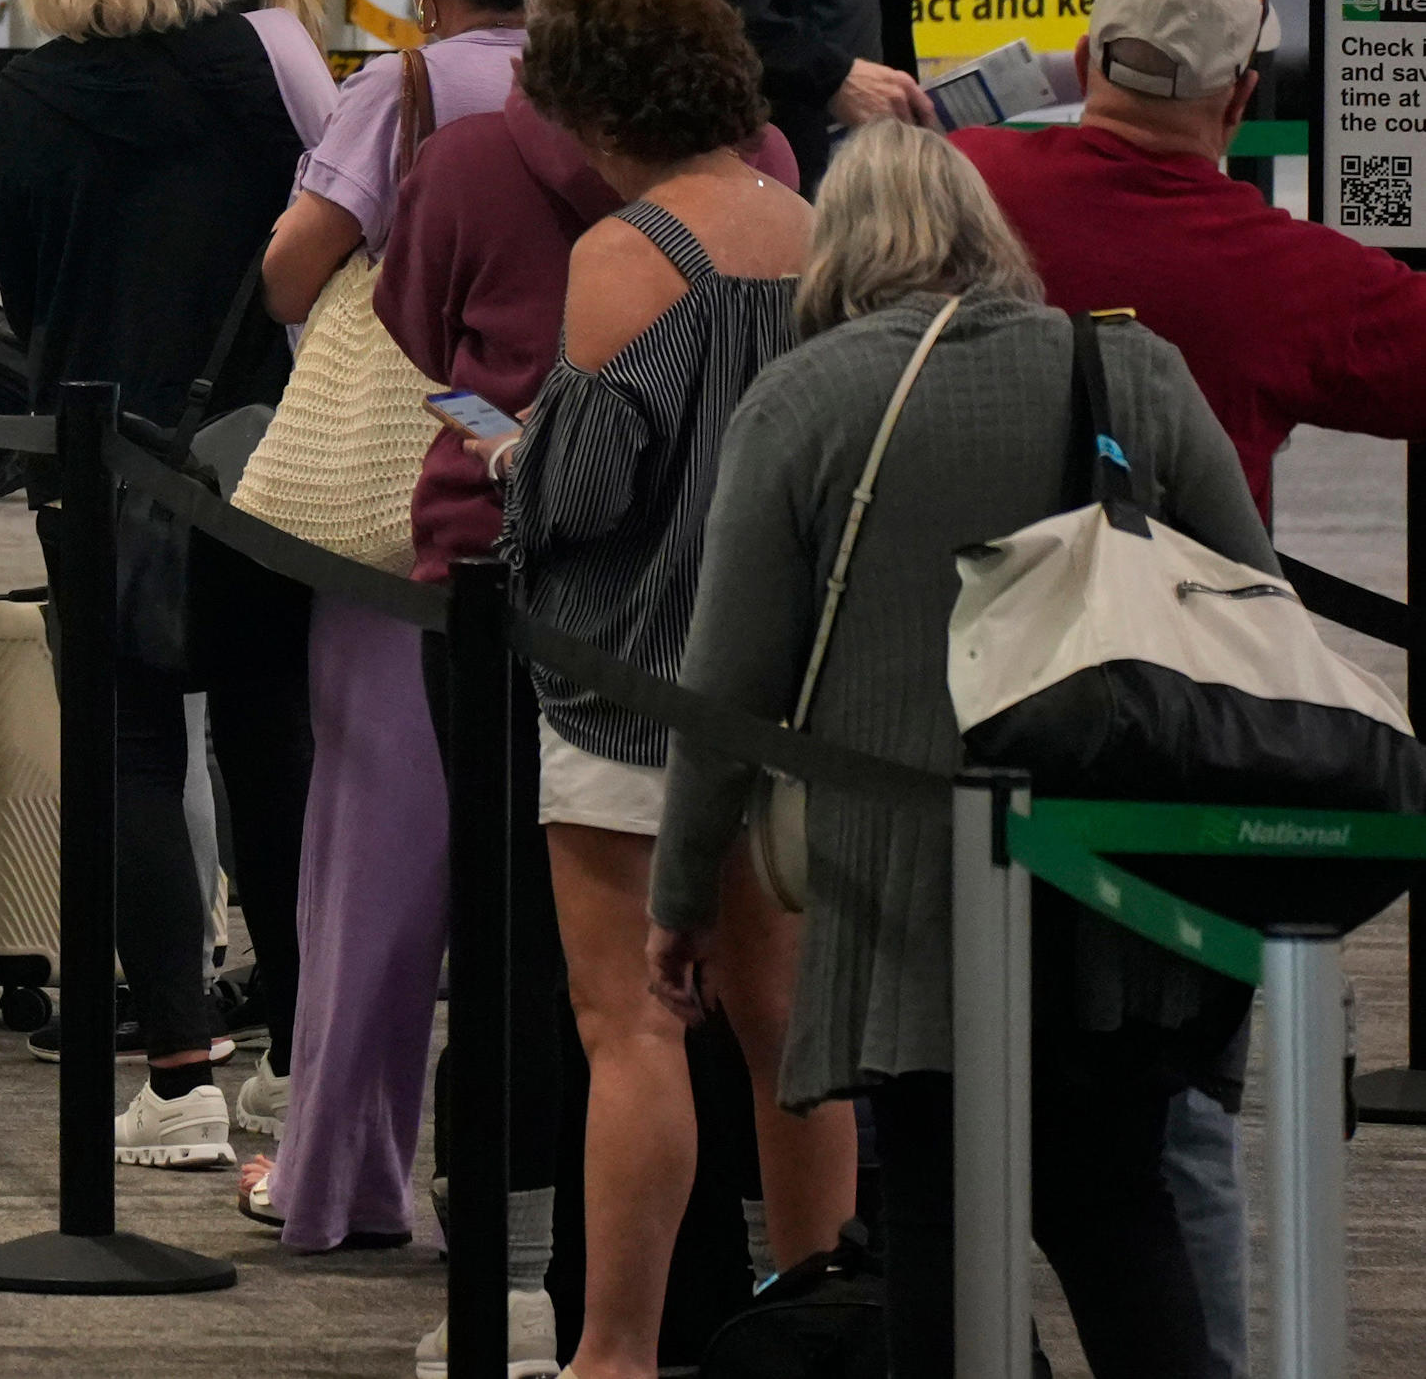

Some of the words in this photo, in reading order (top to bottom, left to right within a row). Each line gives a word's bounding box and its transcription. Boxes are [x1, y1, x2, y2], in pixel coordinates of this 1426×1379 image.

[1342, 36, 1414, 57] Check
[1341, 62, 1384, 82] and
[1341, 87, 1391, 107] time
[1398, 89, 1421, 108] at
[1341, 112, 1377, 132] the
[1237, 819, 1352, 846] National
